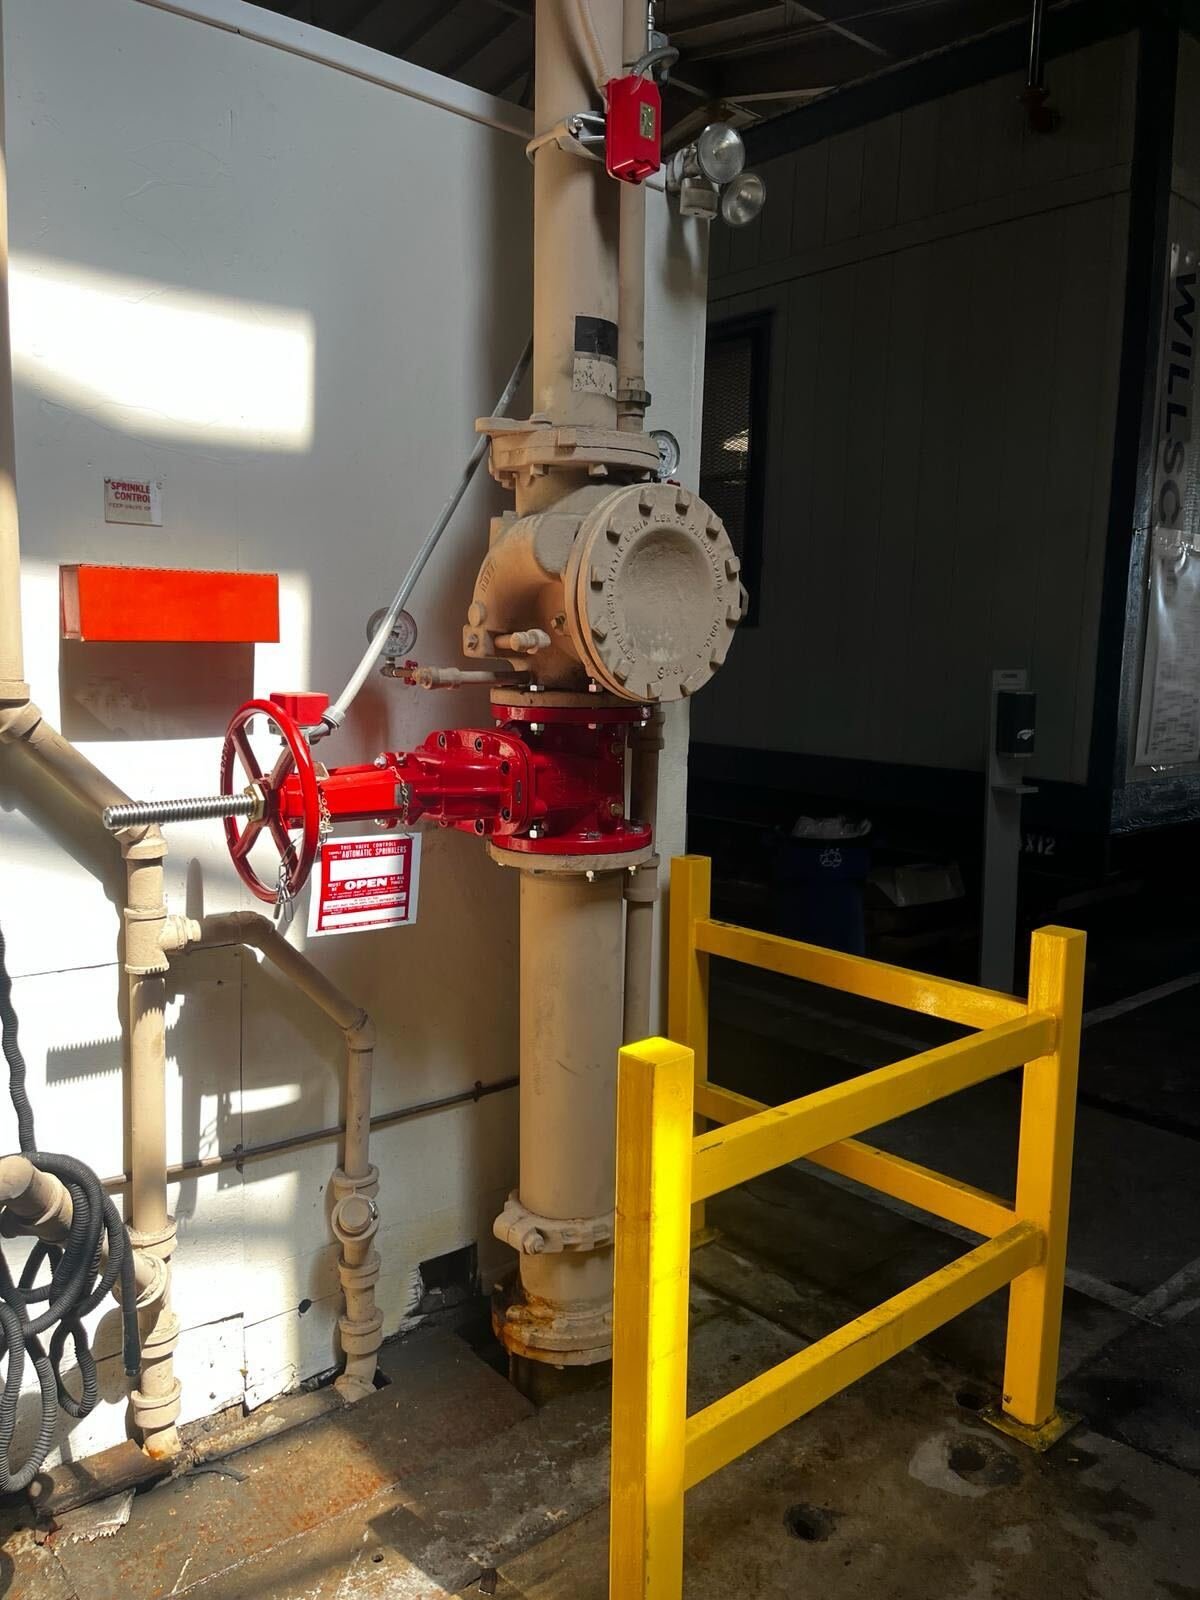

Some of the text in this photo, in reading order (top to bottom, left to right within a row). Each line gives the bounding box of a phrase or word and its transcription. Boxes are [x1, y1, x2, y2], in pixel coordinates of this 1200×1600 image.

[1158, 272, 1197, 526] WILLSC
[341, 845, 407, 859] AUTOMATIC SPRINKLERS
[344, 878, 388, 891] OPEN
